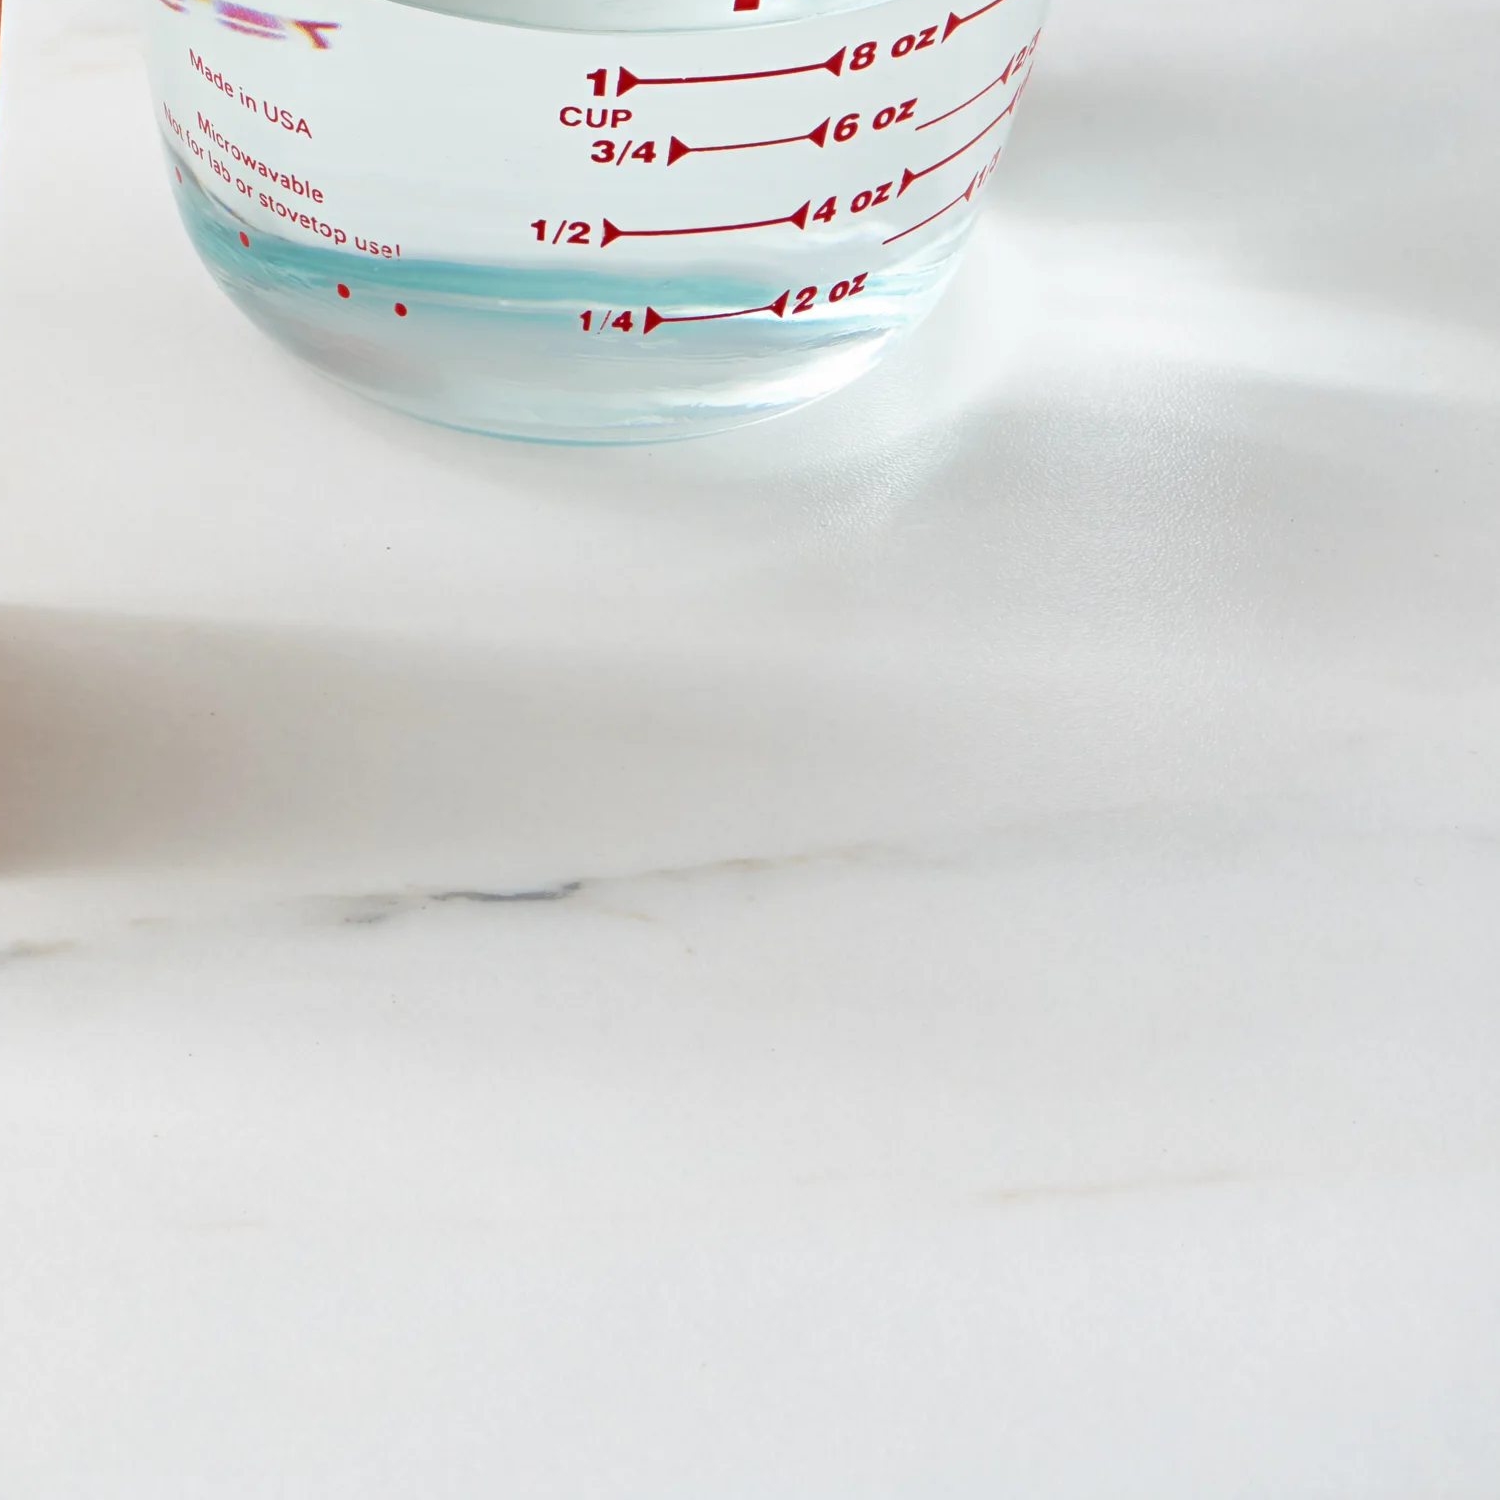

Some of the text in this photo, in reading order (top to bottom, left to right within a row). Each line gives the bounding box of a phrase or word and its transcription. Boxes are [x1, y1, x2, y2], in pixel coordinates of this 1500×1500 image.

[848, 25, 939, 70] 8 oz
[189, 48, 313, 139] Made in USA
[586, 68, 607, 96] 1
[559, 106, 633, 128] CUP
[832, 98, 919, 143] 6 oz
[197, 111, 324, 203] Microwavable
[590, 141, 657, 166] 3/4
[163, 100, 401, 261] Not for lab or stovetop use!
[812, 182, 894, 223] 4 oz
[531, 219, 591, 245] 1/2
[792, 273, 869, 314] 2 oz
[580, 310, 634, 334] 1/4
